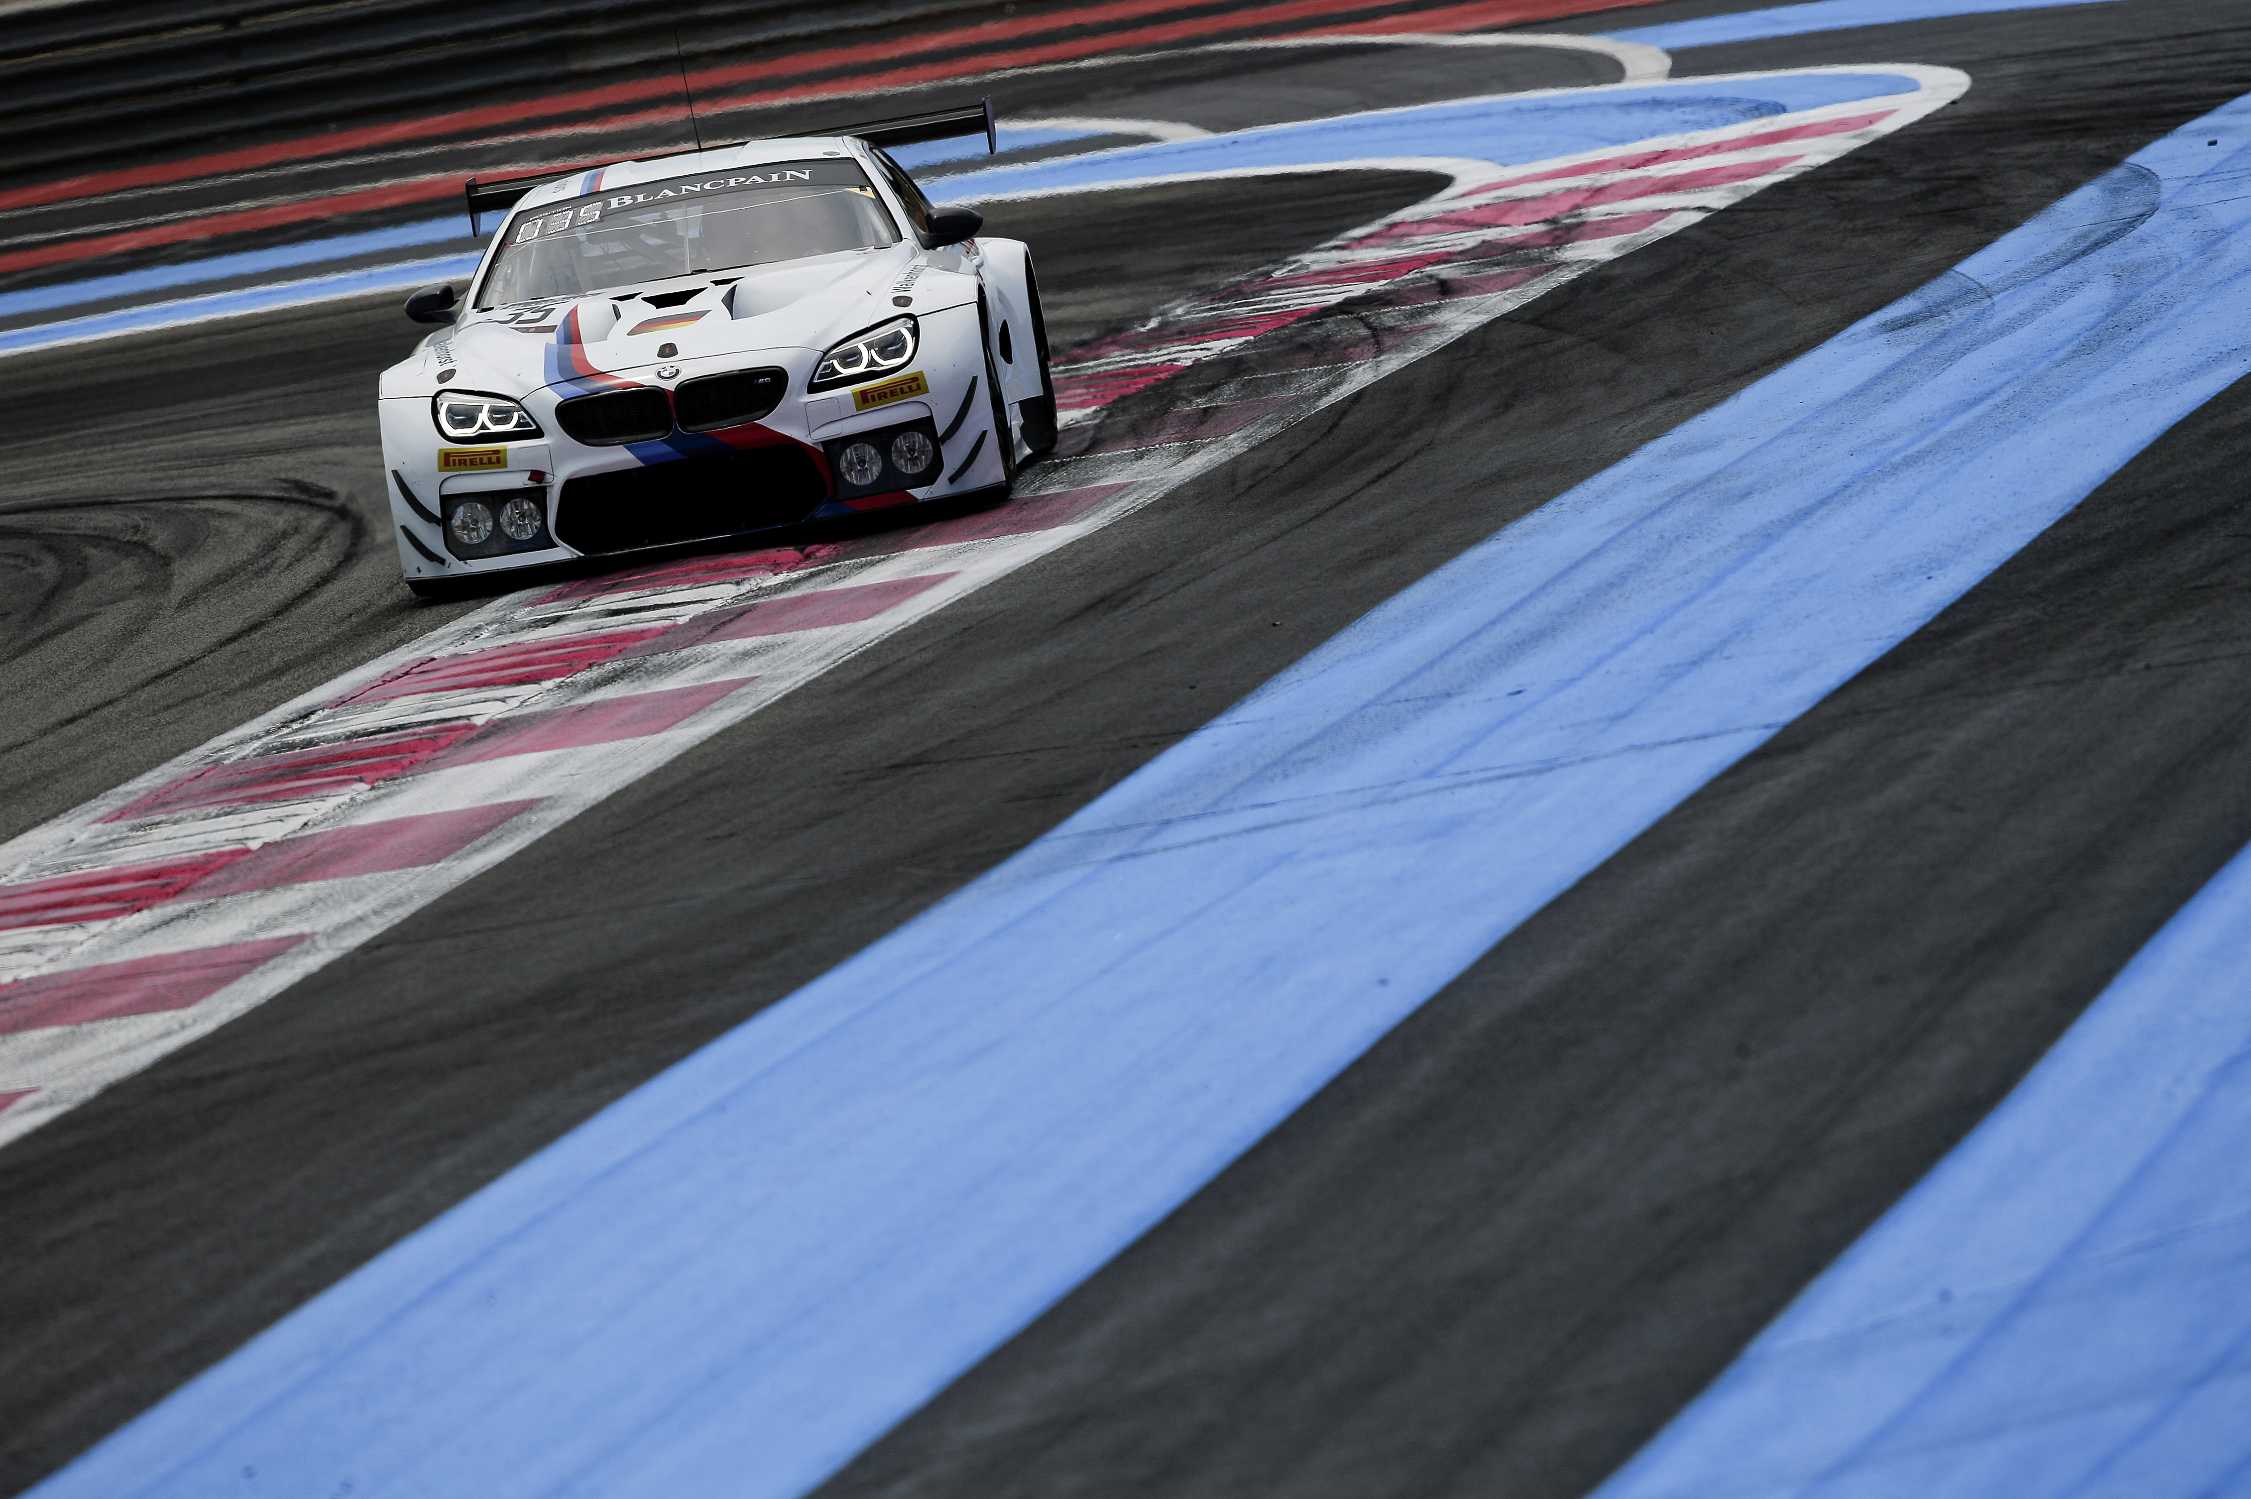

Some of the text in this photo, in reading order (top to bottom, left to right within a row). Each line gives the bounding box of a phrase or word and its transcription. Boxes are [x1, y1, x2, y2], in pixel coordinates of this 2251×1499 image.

[607, 169, 813, 210] BLANCPAIN
[859, 376, 921, 405] PIRELLI
[443, 449, 502, 468] PIRELLI
